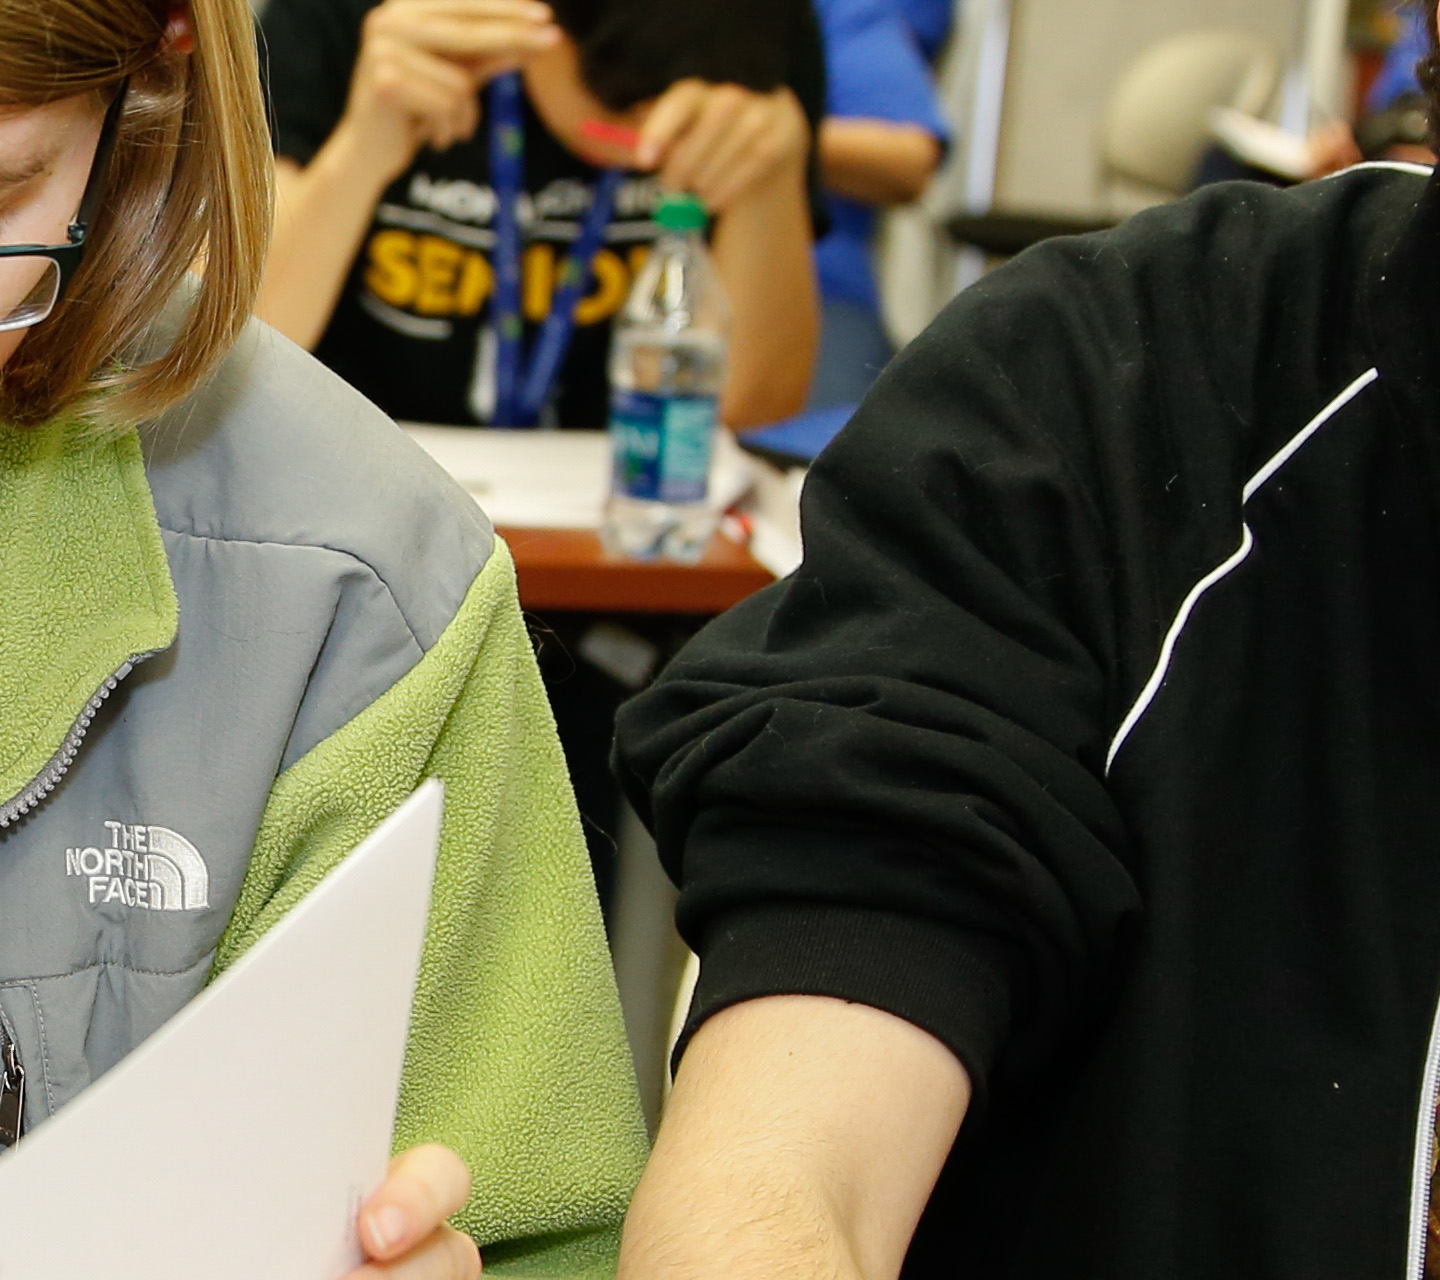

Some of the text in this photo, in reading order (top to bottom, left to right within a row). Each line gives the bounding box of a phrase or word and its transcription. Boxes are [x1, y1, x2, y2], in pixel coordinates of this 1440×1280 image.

[104, 820, 148, 853] THE
[65, 847, 149, 881] NORTH
[89, 876, 149, 909] FACE
